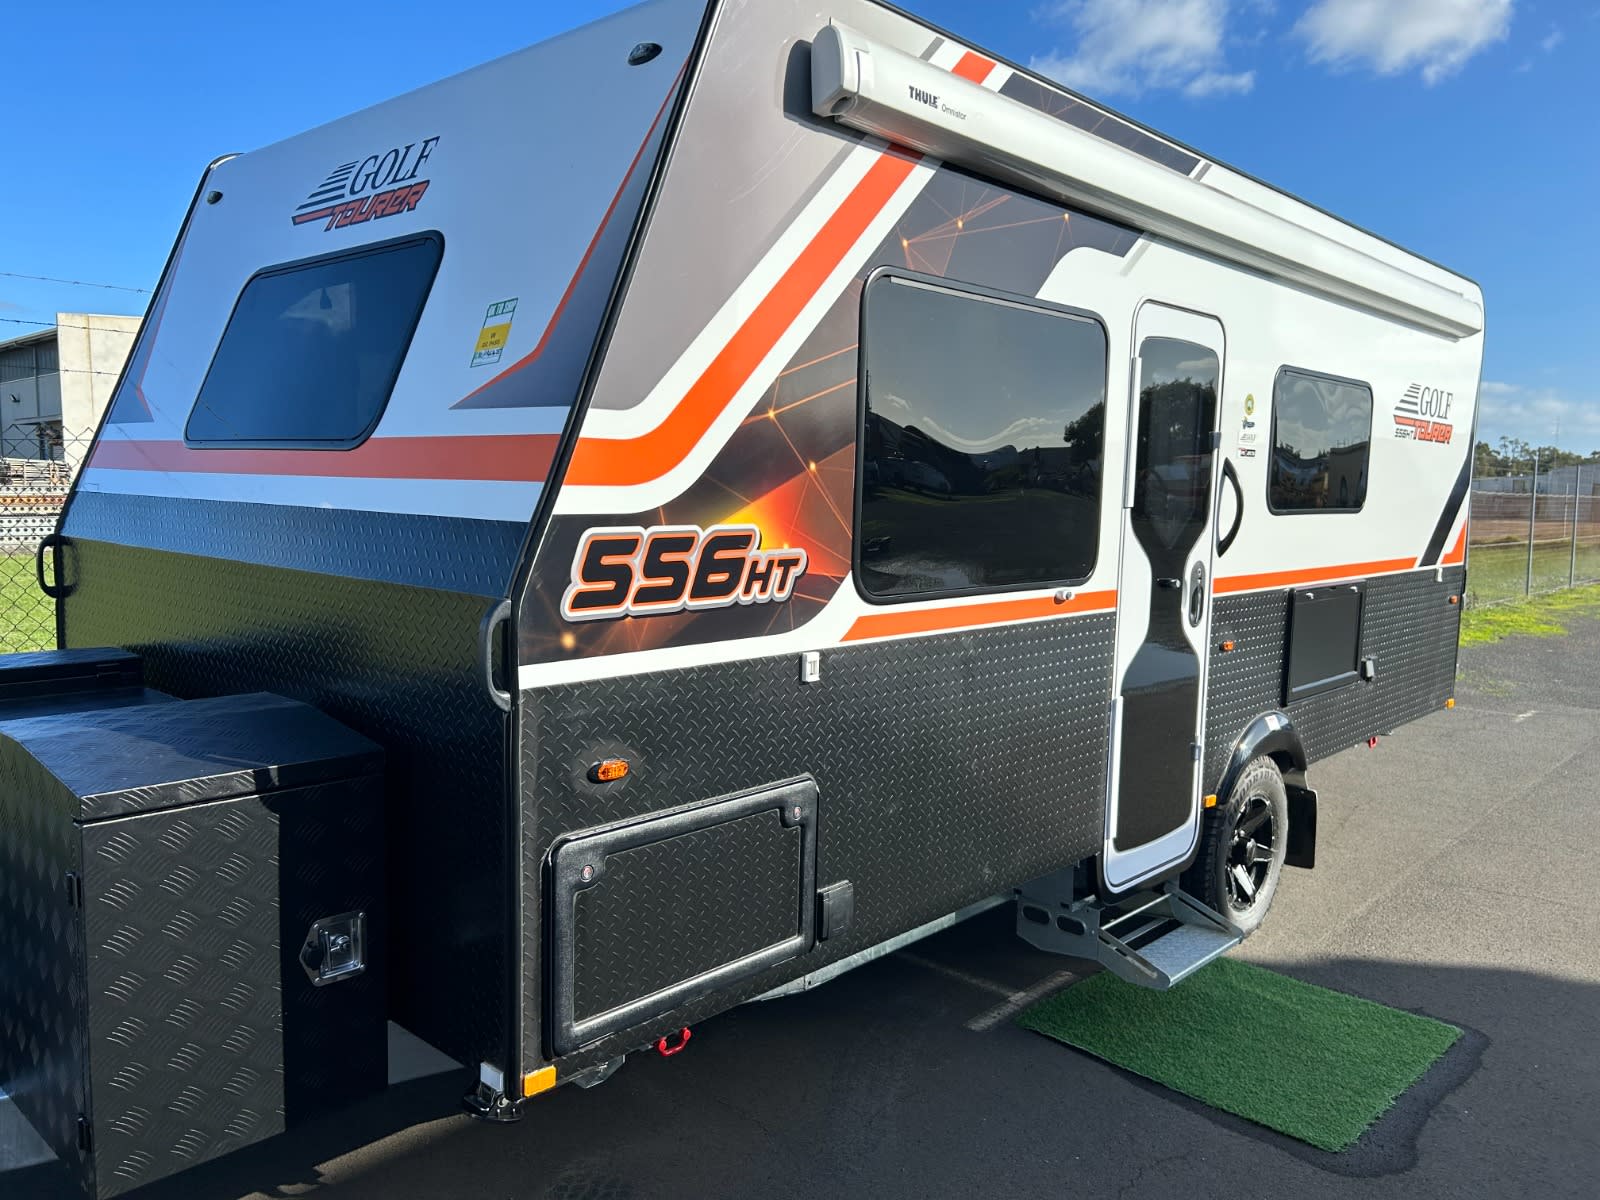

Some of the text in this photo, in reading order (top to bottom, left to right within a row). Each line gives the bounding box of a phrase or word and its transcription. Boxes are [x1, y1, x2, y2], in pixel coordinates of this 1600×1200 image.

[908, 85, 967, 120] THULE Omnistor
[349, 135, 441, 196] GOLF
[323, 179, 431, 232] TOURER
[1420, 386, 1453, 420] GOLF
[1413, 417, 1453, 445] TOURER
